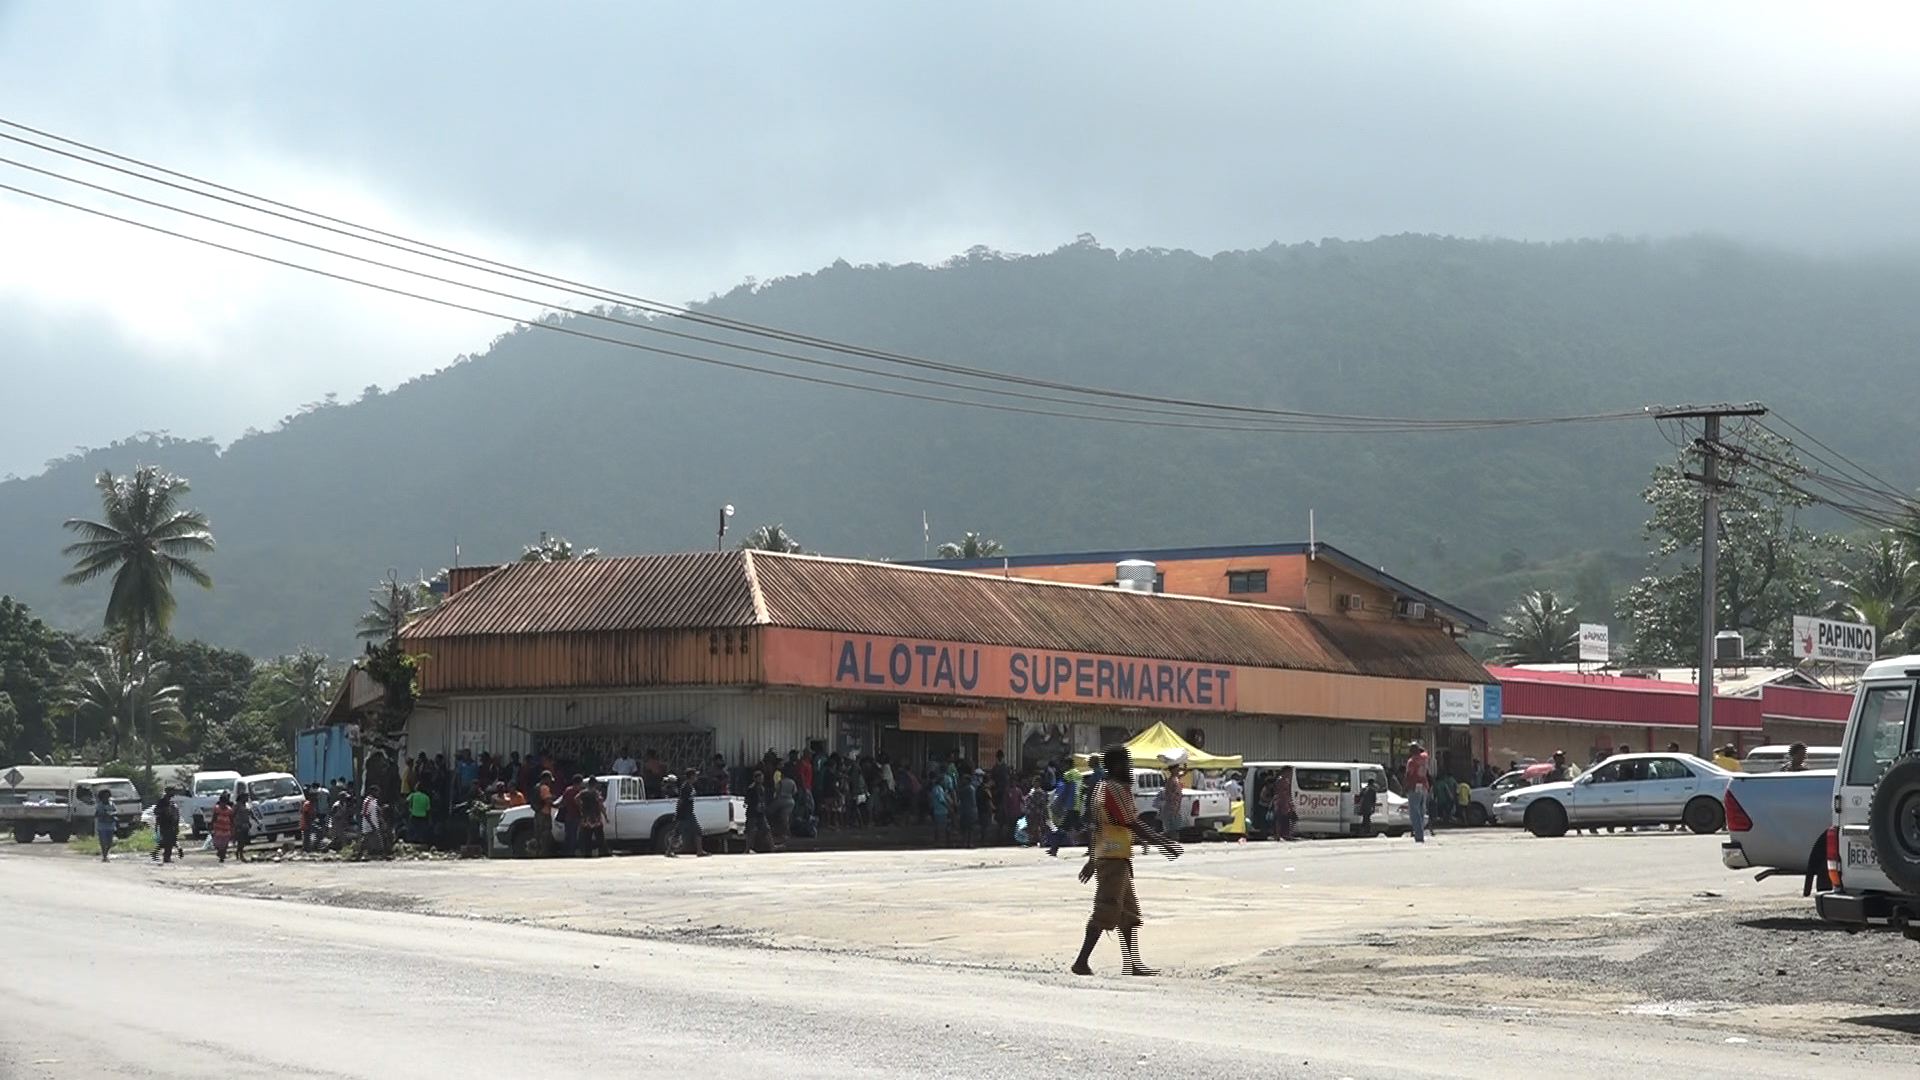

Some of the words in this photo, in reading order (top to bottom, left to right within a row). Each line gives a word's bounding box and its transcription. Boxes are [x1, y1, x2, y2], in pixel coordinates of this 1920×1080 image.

[1818, 623, 1872, 651] PAPINDO
[836, 640, 979, 690] ALOTAU
[1009, 652, 1231, 704] SUPERMARKET
[1299, 794, 1338, 809] Digicel
